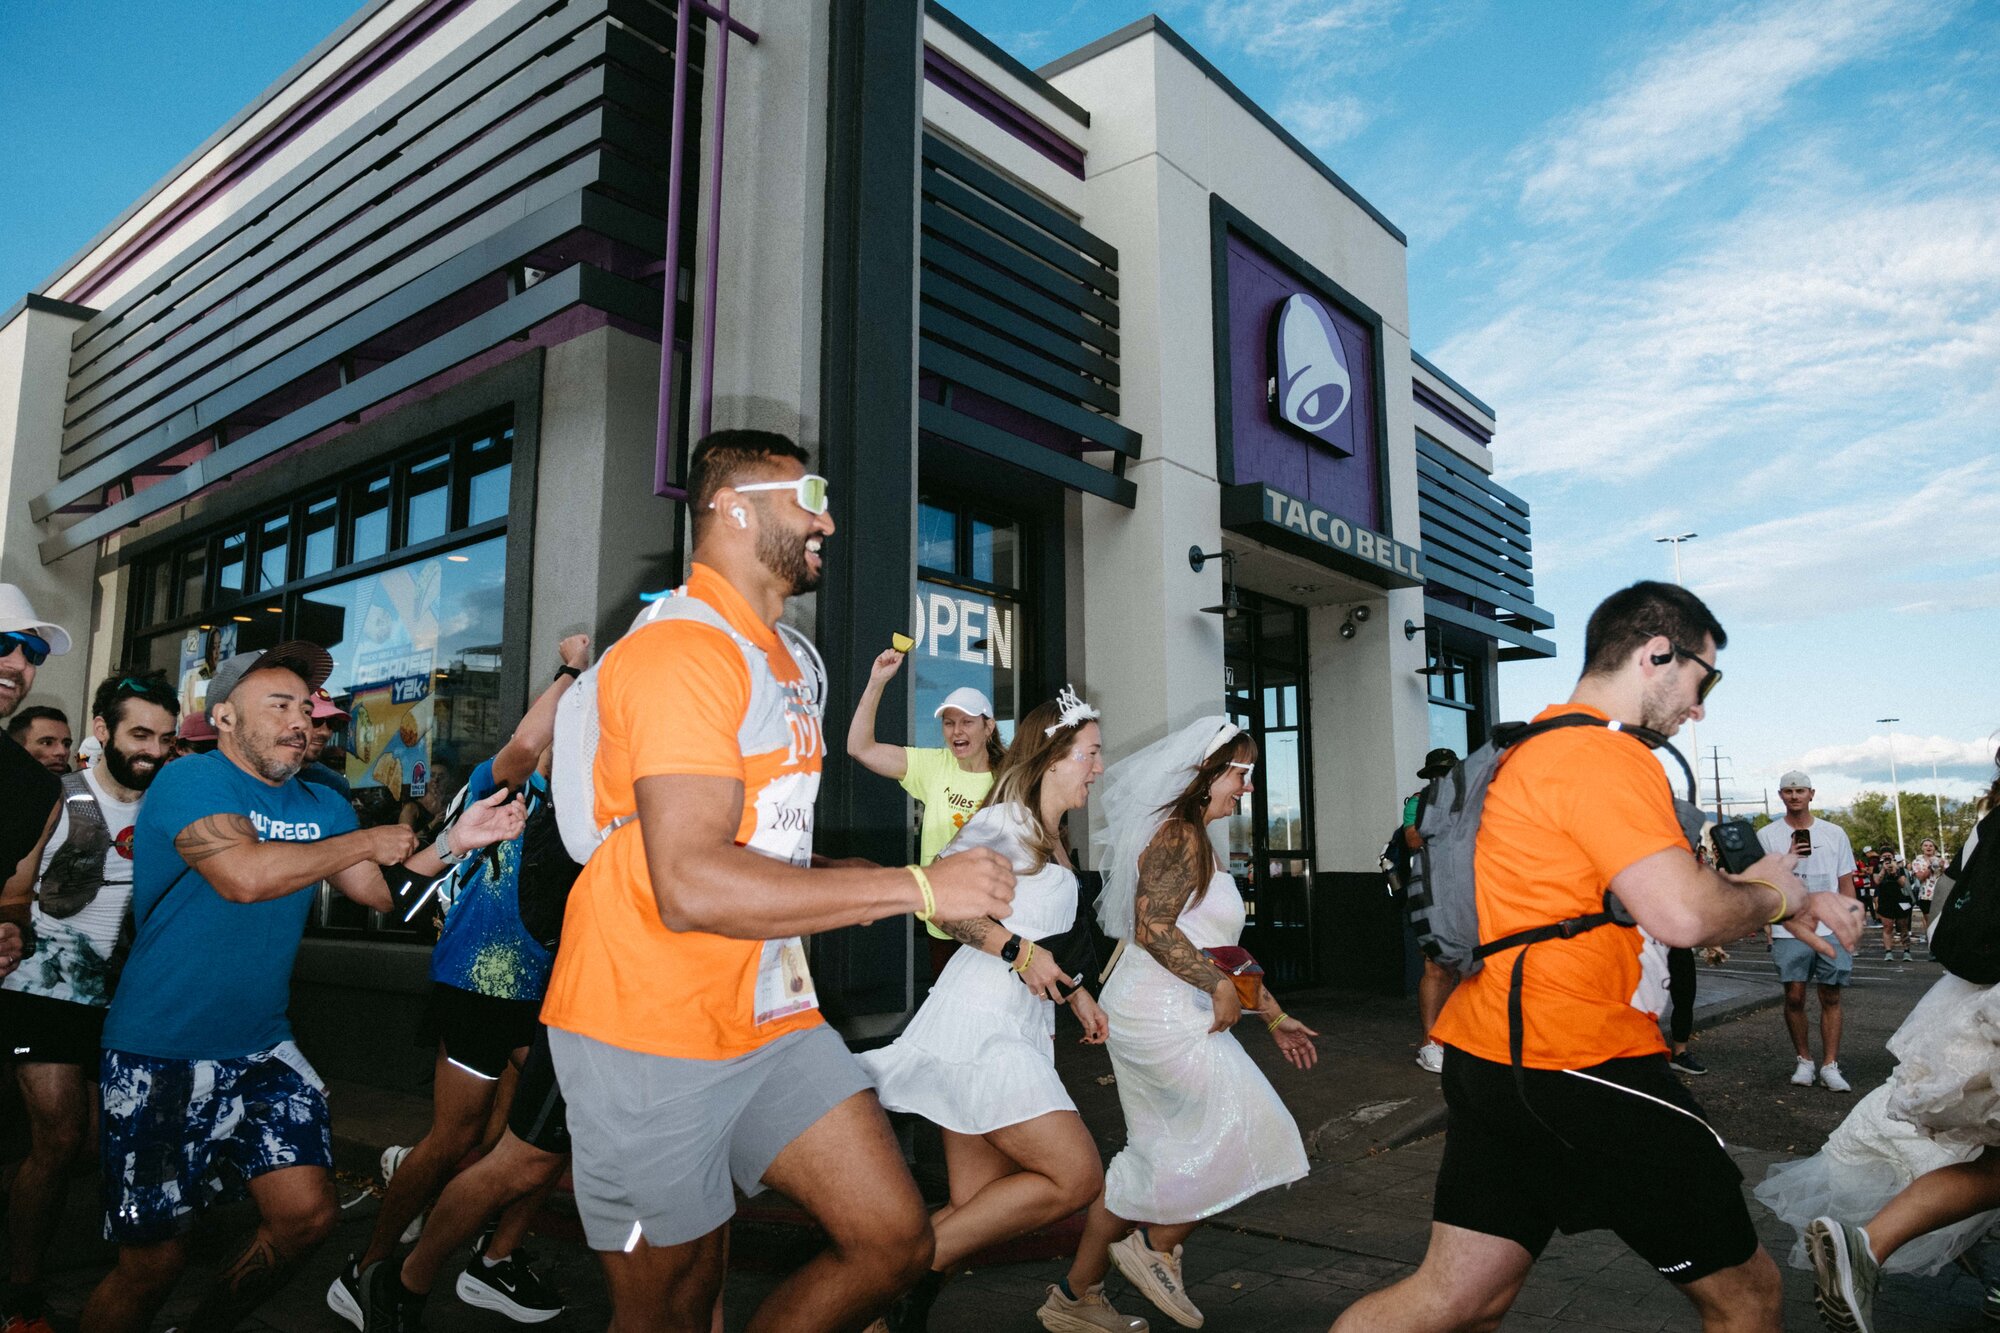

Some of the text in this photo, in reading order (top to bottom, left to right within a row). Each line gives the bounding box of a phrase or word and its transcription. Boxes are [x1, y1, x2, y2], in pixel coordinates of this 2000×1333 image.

[1266, 488, 1424, 580] TACO BELL
[394, 678, 424, 701] Y2K
[1150, 1262, 1176, 1295] HOKA
